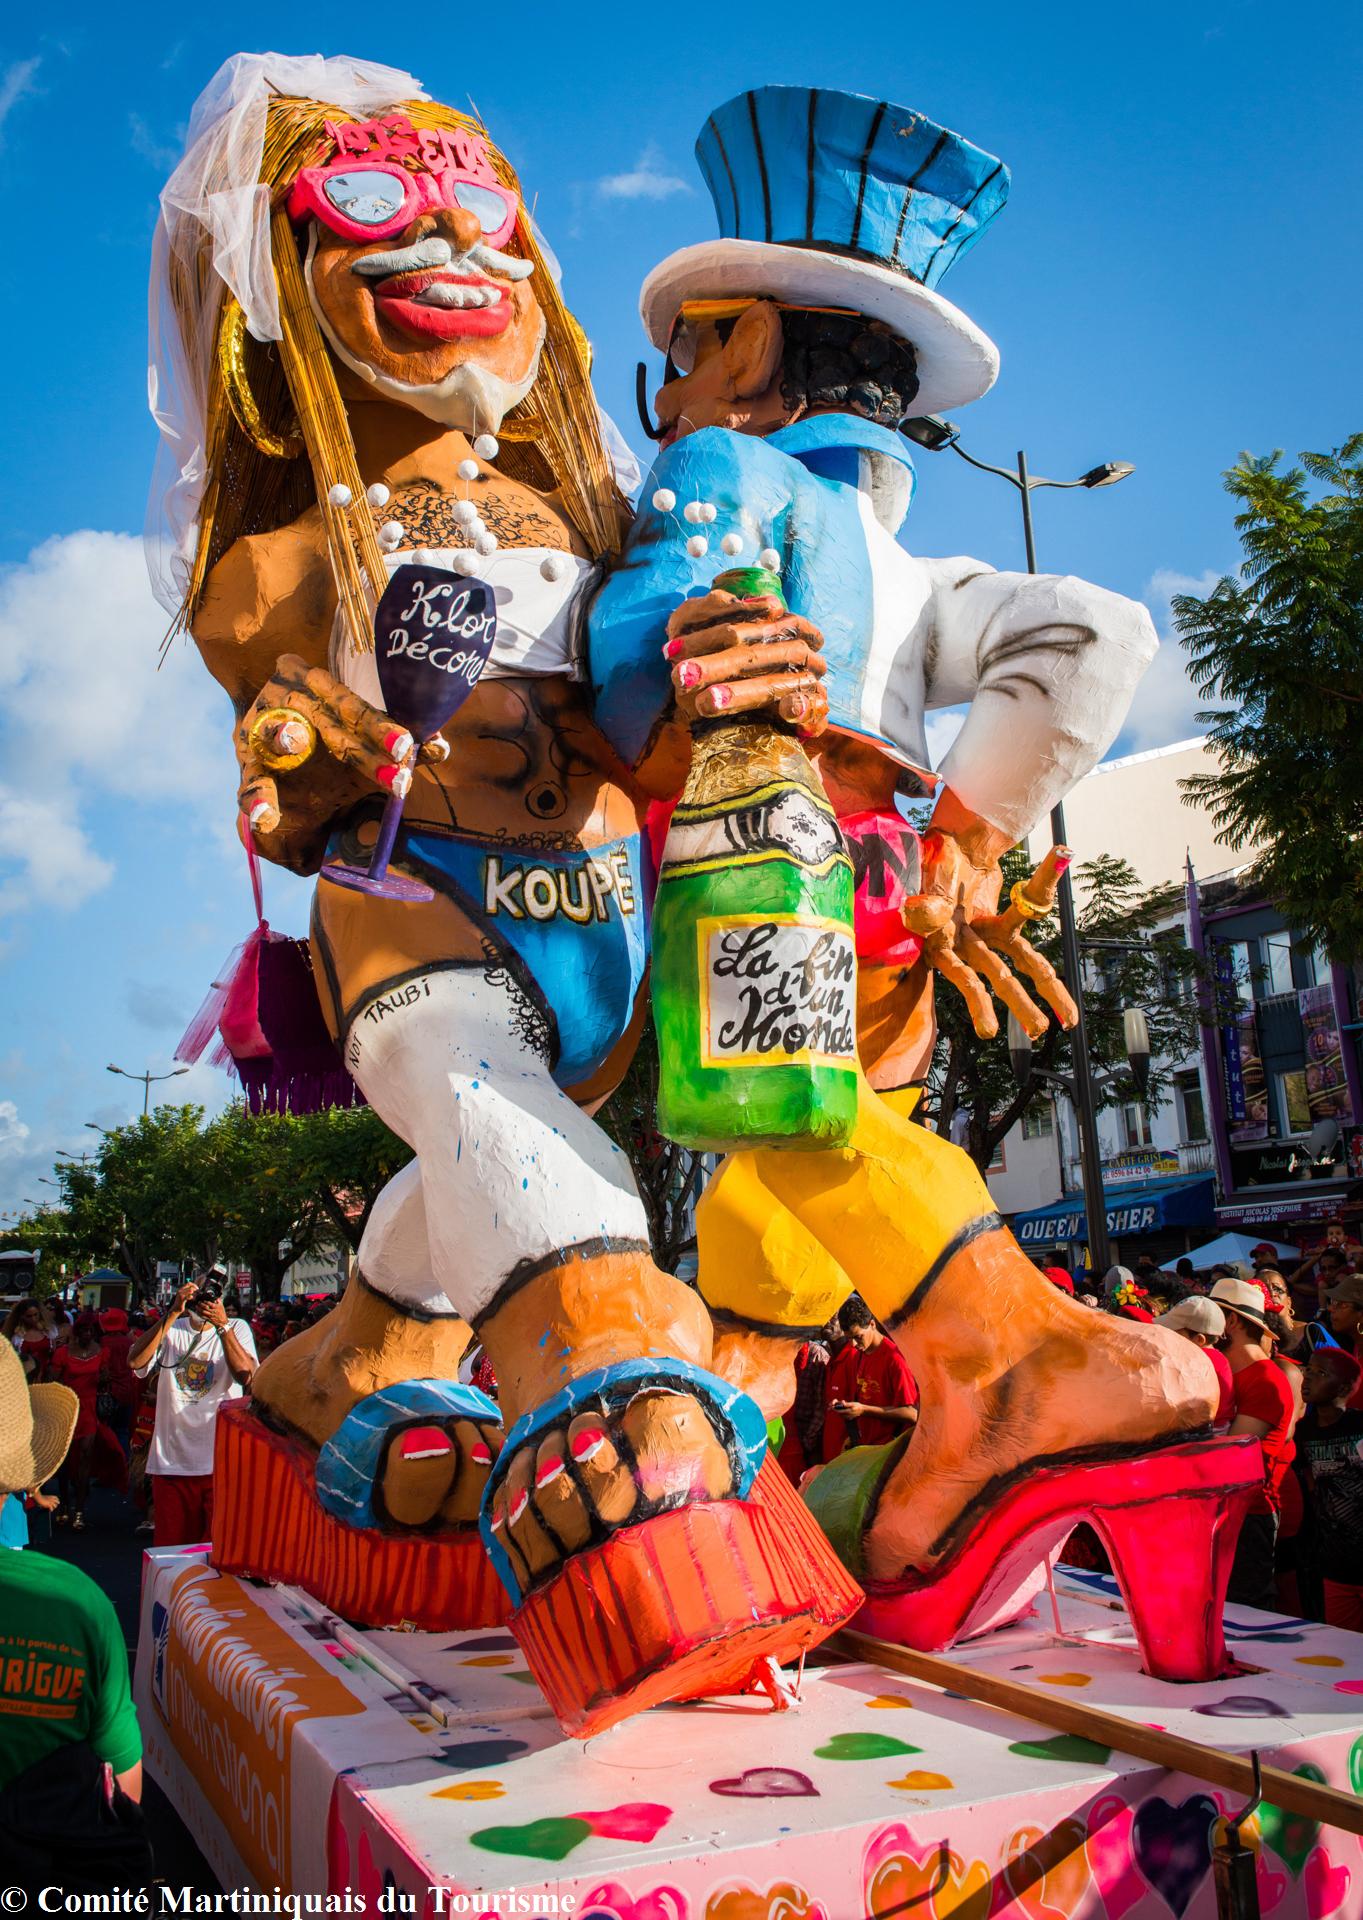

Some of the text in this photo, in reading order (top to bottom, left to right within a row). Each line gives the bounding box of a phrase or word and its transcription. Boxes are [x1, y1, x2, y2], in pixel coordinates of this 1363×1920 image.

[400, 581, 495, 643] Klor
[483, 841, 635, 926] KOUPÉ
[713, 923, 853, 997] La fin
[718, 985, 854, 1054] Monde
[1108, 1156, 1136, 1168] CARTE
[1021, 1216, 1080, 1239] QUEEN
